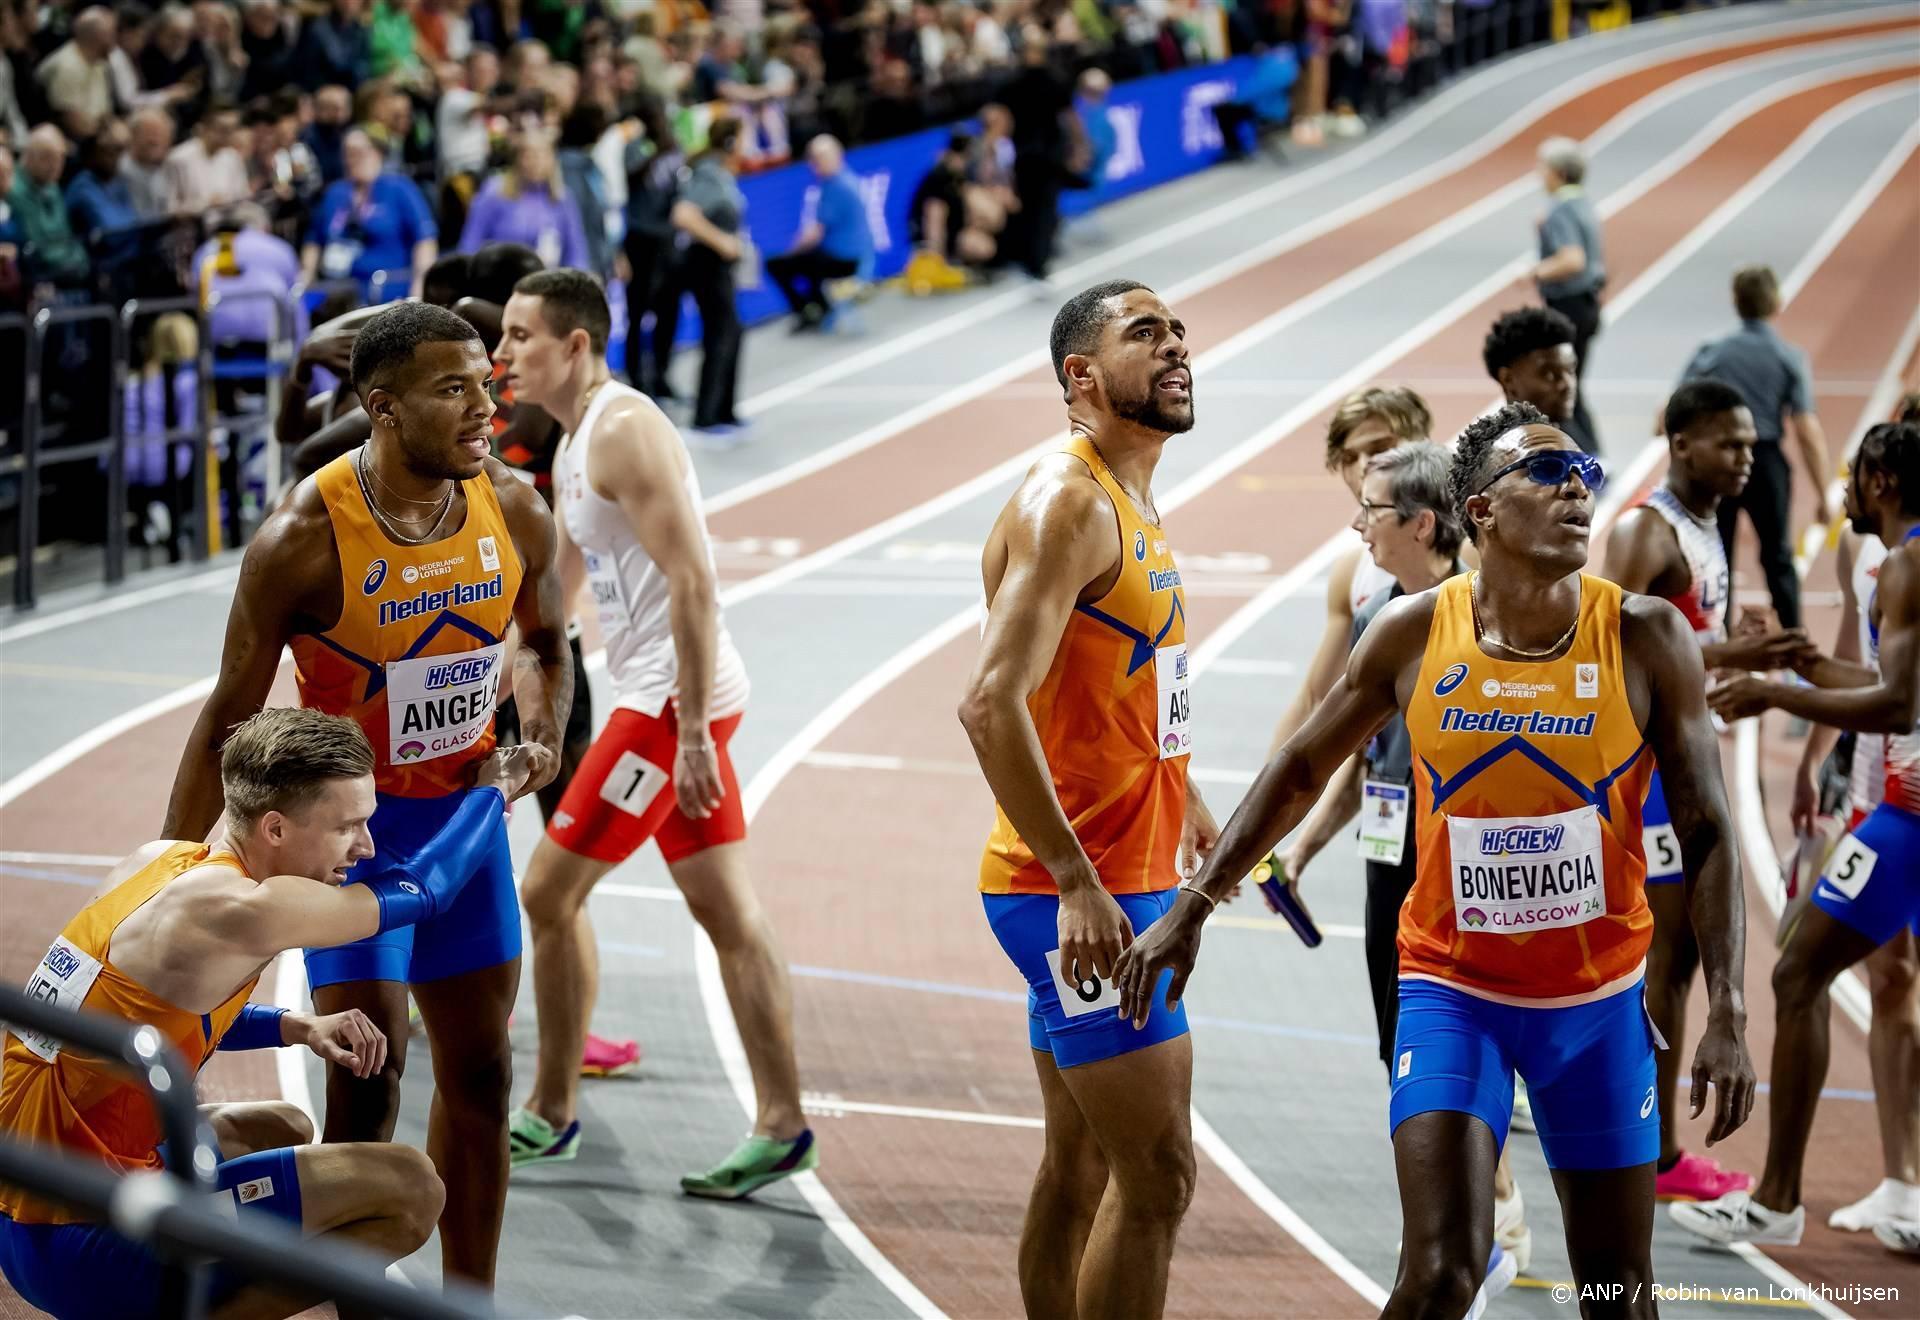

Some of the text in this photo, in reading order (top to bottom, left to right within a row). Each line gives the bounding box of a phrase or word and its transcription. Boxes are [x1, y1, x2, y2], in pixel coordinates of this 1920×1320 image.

[419, 556, 465, 571] NEDERLANDSE
[420, 566, 452, 579] LOTERIJ
[424, 653, 498, 690] HI-CHEW
[1501, 682, 1557, 692] NEDERLANDSE
[401, 672, 498, 735] ANGELA
[1500, 689, 1537, 698] LOTERIJ
[623, 768, 645, 801] 1
[1480, 824, 1565, 856] HI-CHEW
[1656, 834, 1675, 867] 5
[1459, 854, 1598, 901] BONEVACIA
[1836, 851, 1863, 881] 5
[1493, 897, 1601, 926] GLASGOW 24
